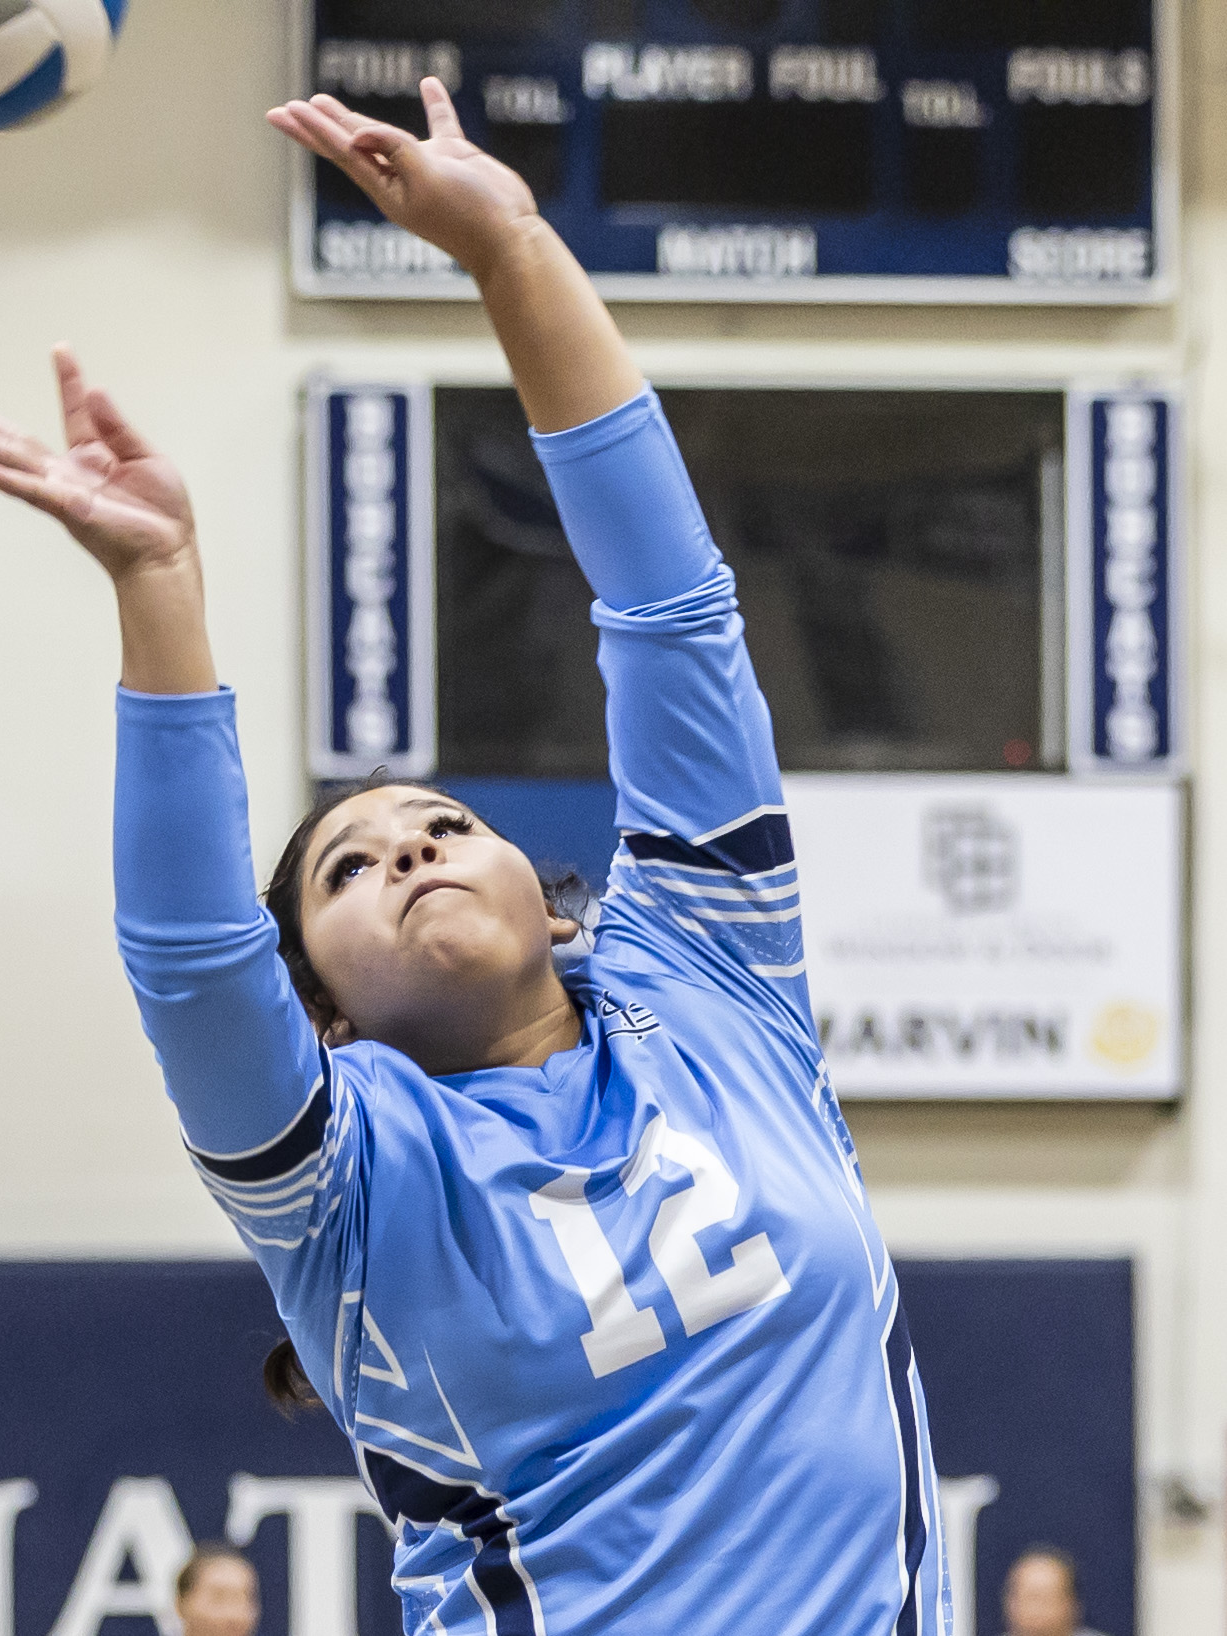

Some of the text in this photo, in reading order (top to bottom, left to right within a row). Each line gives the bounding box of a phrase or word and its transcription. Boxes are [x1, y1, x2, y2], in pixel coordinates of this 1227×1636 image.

[581, 44, 885, 101] PLAYER FOUL
[1008, 48, 1149, 106] FOULS
[657, 225, 817, 277] MATCH
[1009, 228, 1150, 284] SCORE
[528, 1110, 792, 1379] 12
